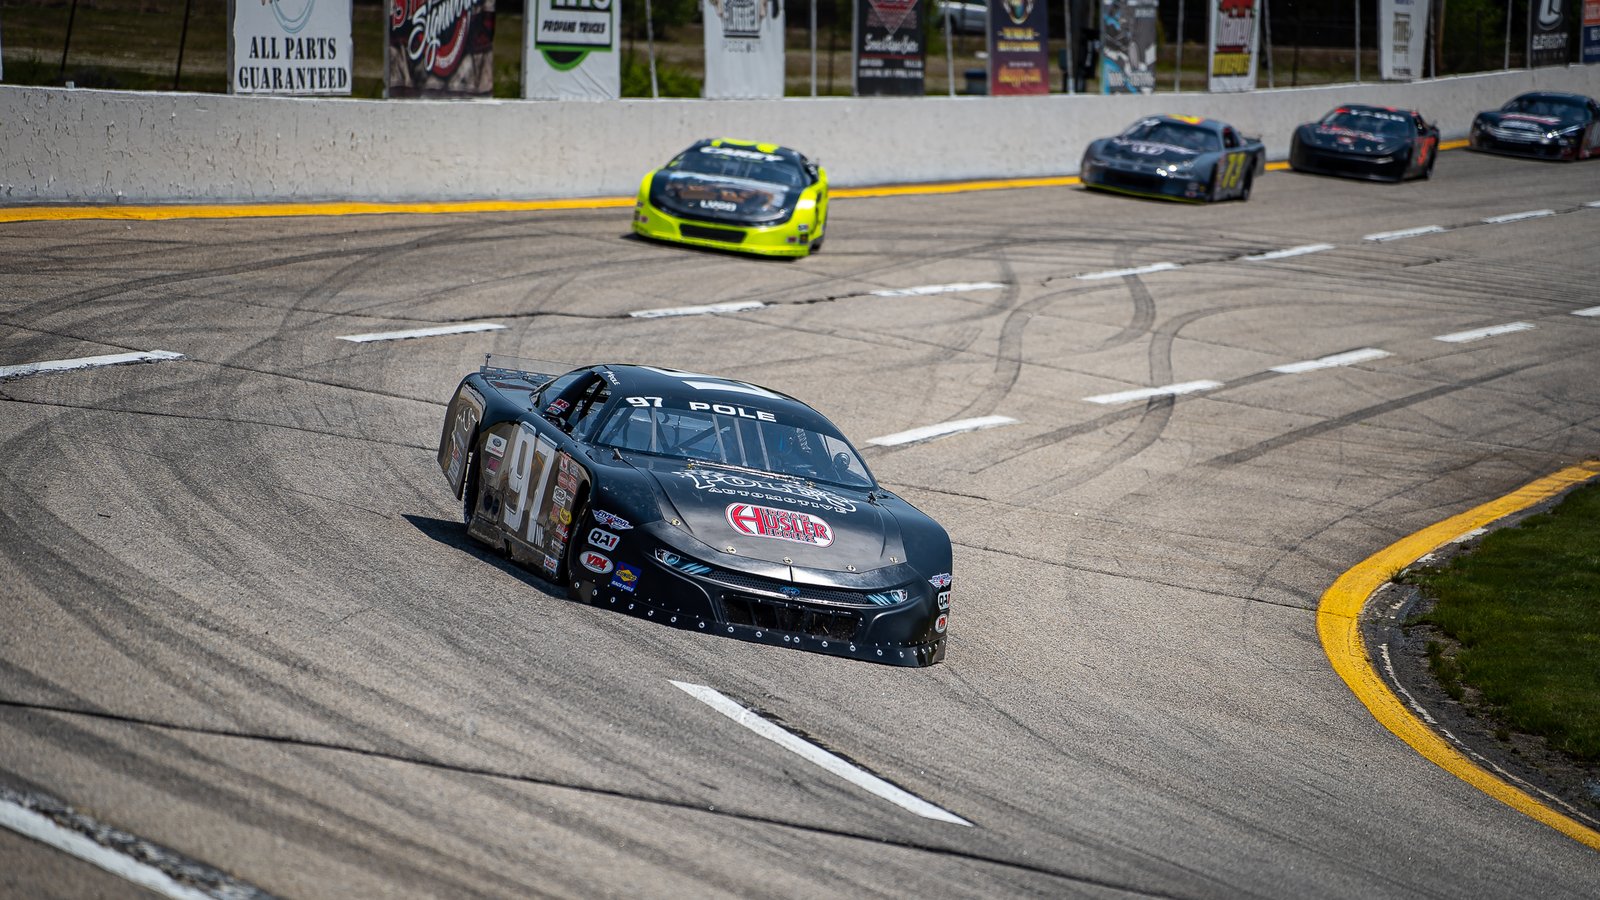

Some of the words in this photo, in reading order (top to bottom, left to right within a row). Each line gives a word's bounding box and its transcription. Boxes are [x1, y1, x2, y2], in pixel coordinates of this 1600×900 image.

[542, 20, 577, 33] PROPANE
[579, 22, 606, 34] TRUCKS
[249, 36, 280, 60] ALL
[285, 37, 337, 60] PARTS
[238, 66, 347, 90] GUARANTEED
[626, 396, 663, 408] 97
[688, 401, 777, 423] POLE
[503, 421, 558, 543] 97
[708, 487, 847, 514] AUTOMOTIVE
[731, 504, 831, 541] HUSLER
[590, 530, 617, 548] QA1
